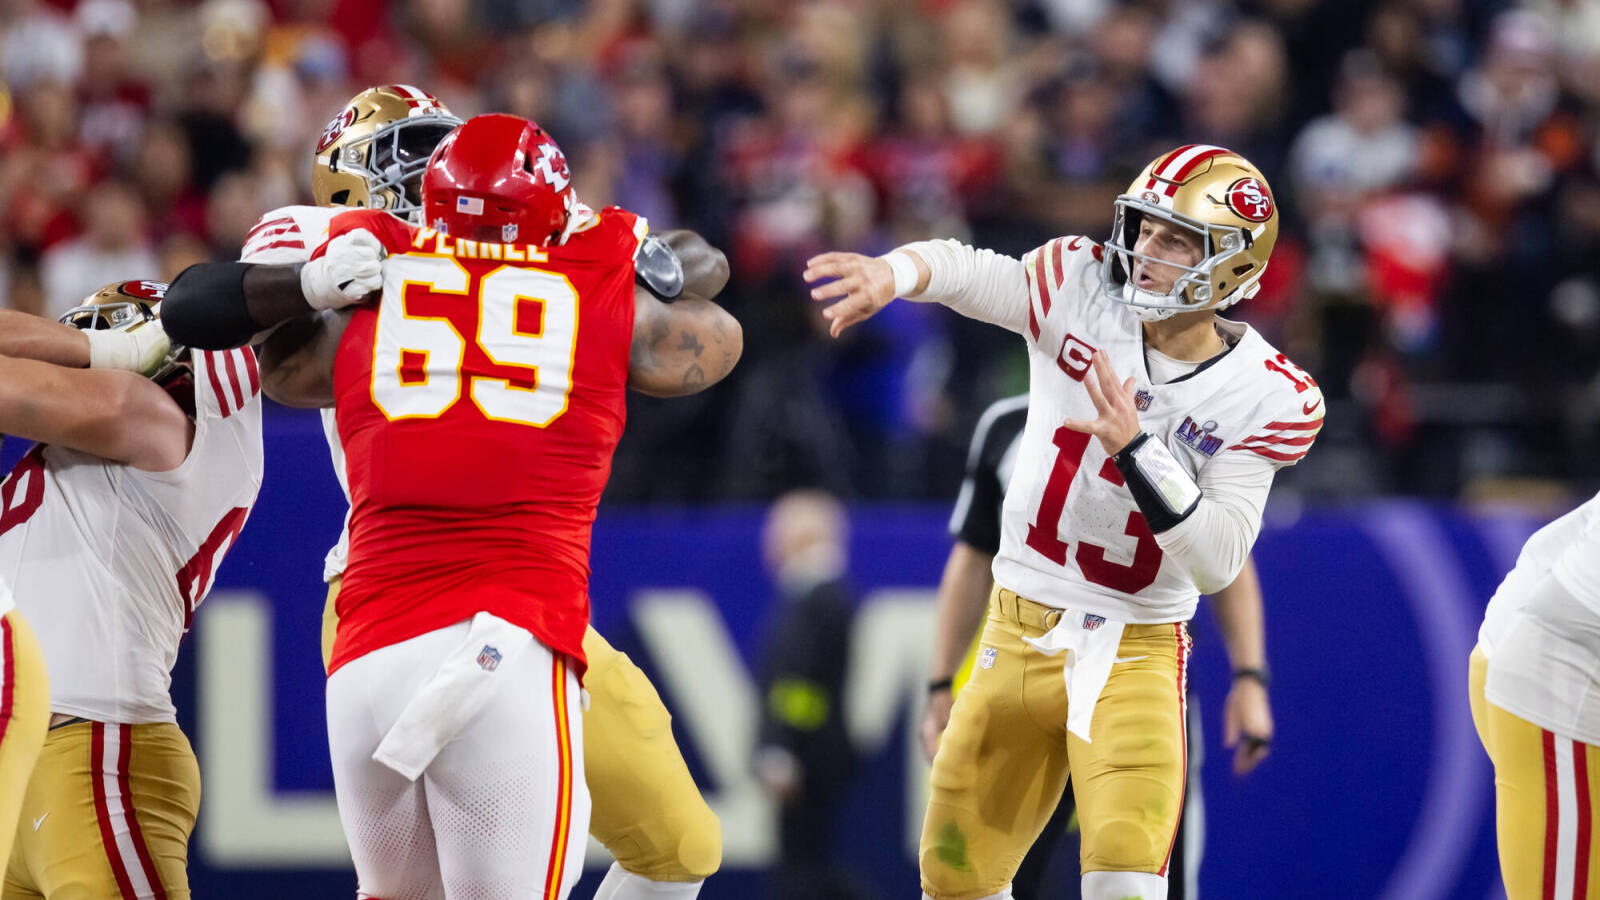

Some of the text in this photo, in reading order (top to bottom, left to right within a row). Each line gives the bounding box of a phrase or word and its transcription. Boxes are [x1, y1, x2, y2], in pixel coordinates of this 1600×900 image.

[1241, 179, 1270, 217] SF
[370, 251, 580, 429] 69
[1062, 338, 1093, 371] C
[1025, 426, 1163, 595] 13
